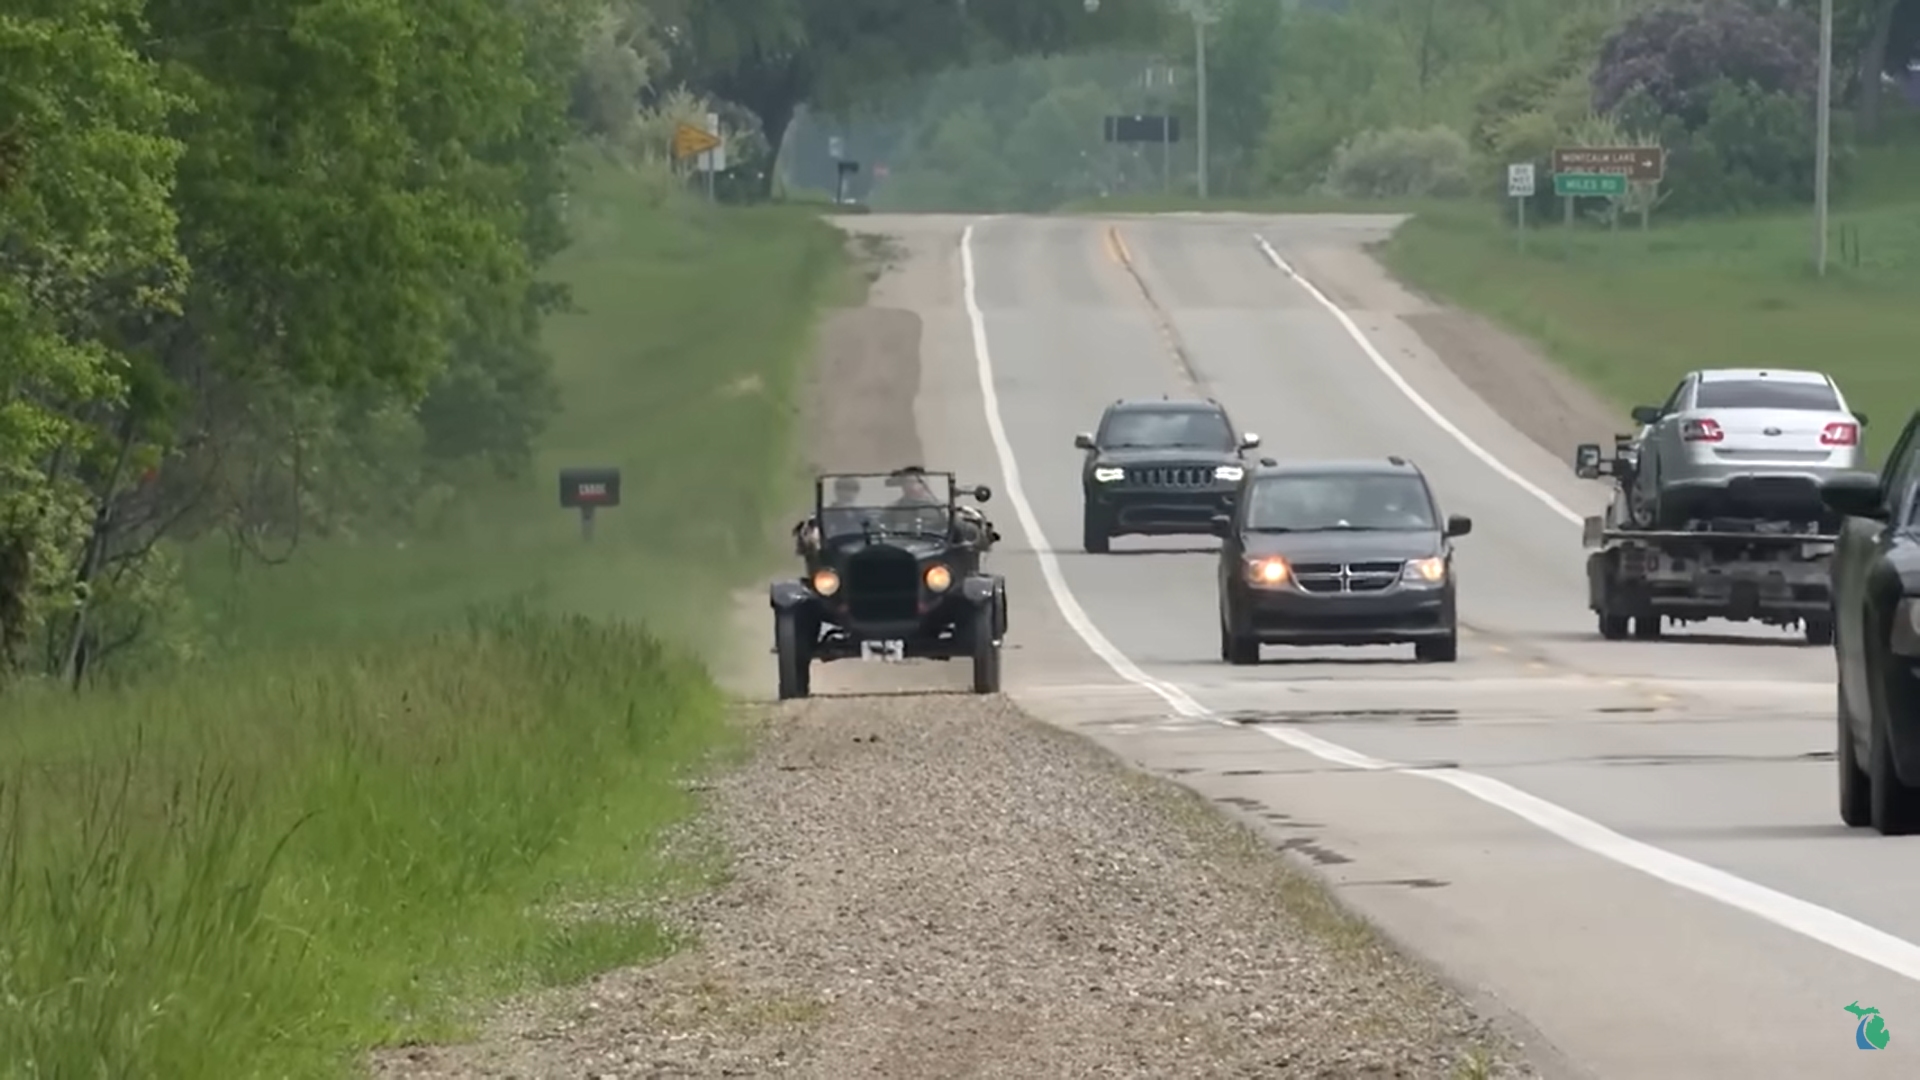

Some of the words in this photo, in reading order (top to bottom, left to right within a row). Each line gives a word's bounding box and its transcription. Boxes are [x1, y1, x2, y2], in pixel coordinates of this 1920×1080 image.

[1561, 153, 1610, 163] MONTCALM
[1613, 153, 1635, 163] LAKE
[1566, 179, 1597, 190] MILES
[1601, 179, 1617, 190] RD
